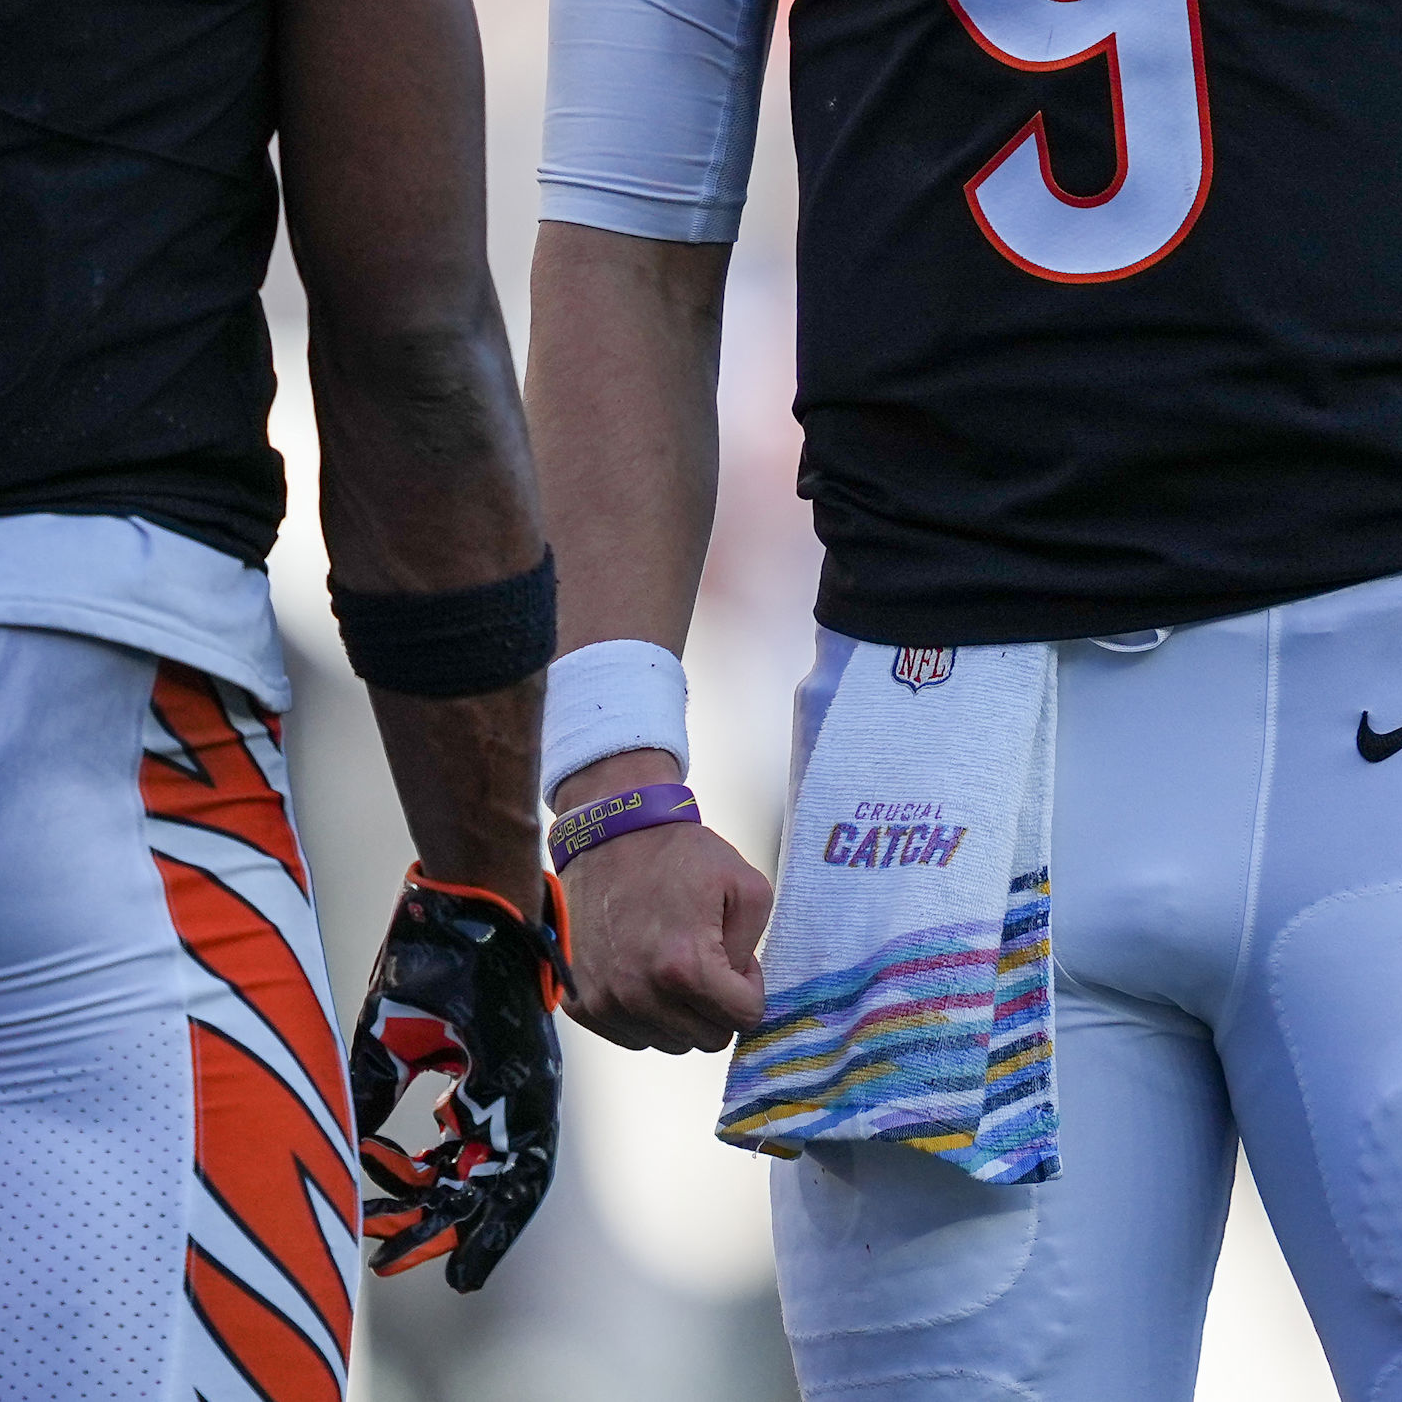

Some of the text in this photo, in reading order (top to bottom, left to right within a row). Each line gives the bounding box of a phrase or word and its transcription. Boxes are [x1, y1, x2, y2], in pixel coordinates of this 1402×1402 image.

[898, 647, 947, 683] NFL
[854, 801, 943, 821] CRUCIAL
[565, 822, 607, 855] LSU
[823, 822, 968, 869] CATCH
